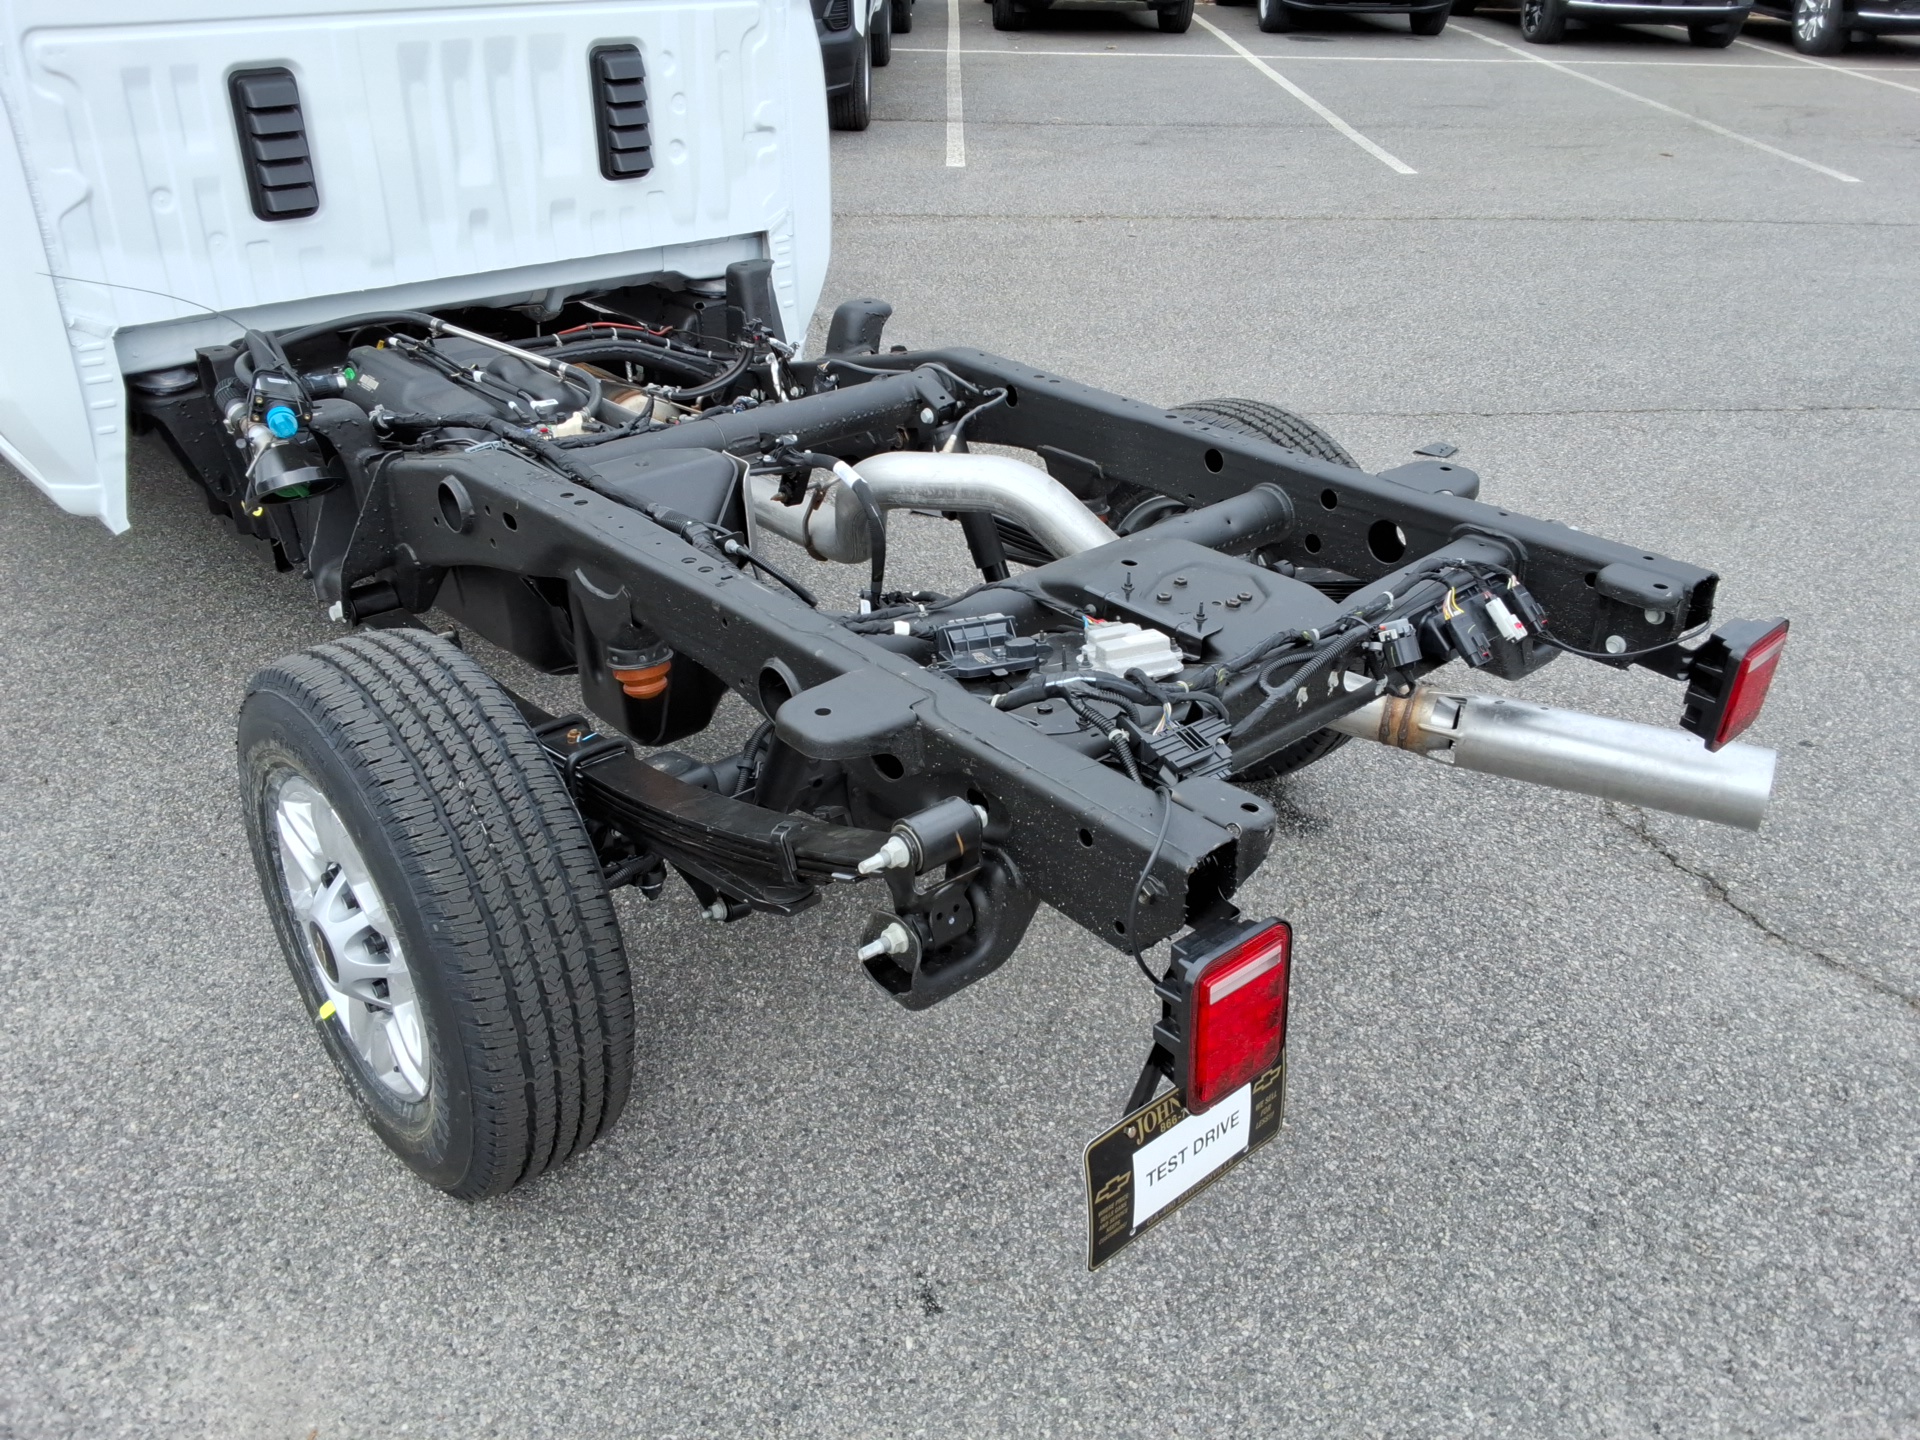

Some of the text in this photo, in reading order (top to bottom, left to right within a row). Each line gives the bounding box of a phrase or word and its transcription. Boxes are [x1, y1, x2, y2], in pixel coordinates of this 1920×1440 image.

[1264, 1090, 1278, 1105] SELL
[1260, 1103, 1272, 1117] FOR
[1146, 1146, 1188, 1187] TEST
[1193, 1110, 1240, 1156] DRIVE
